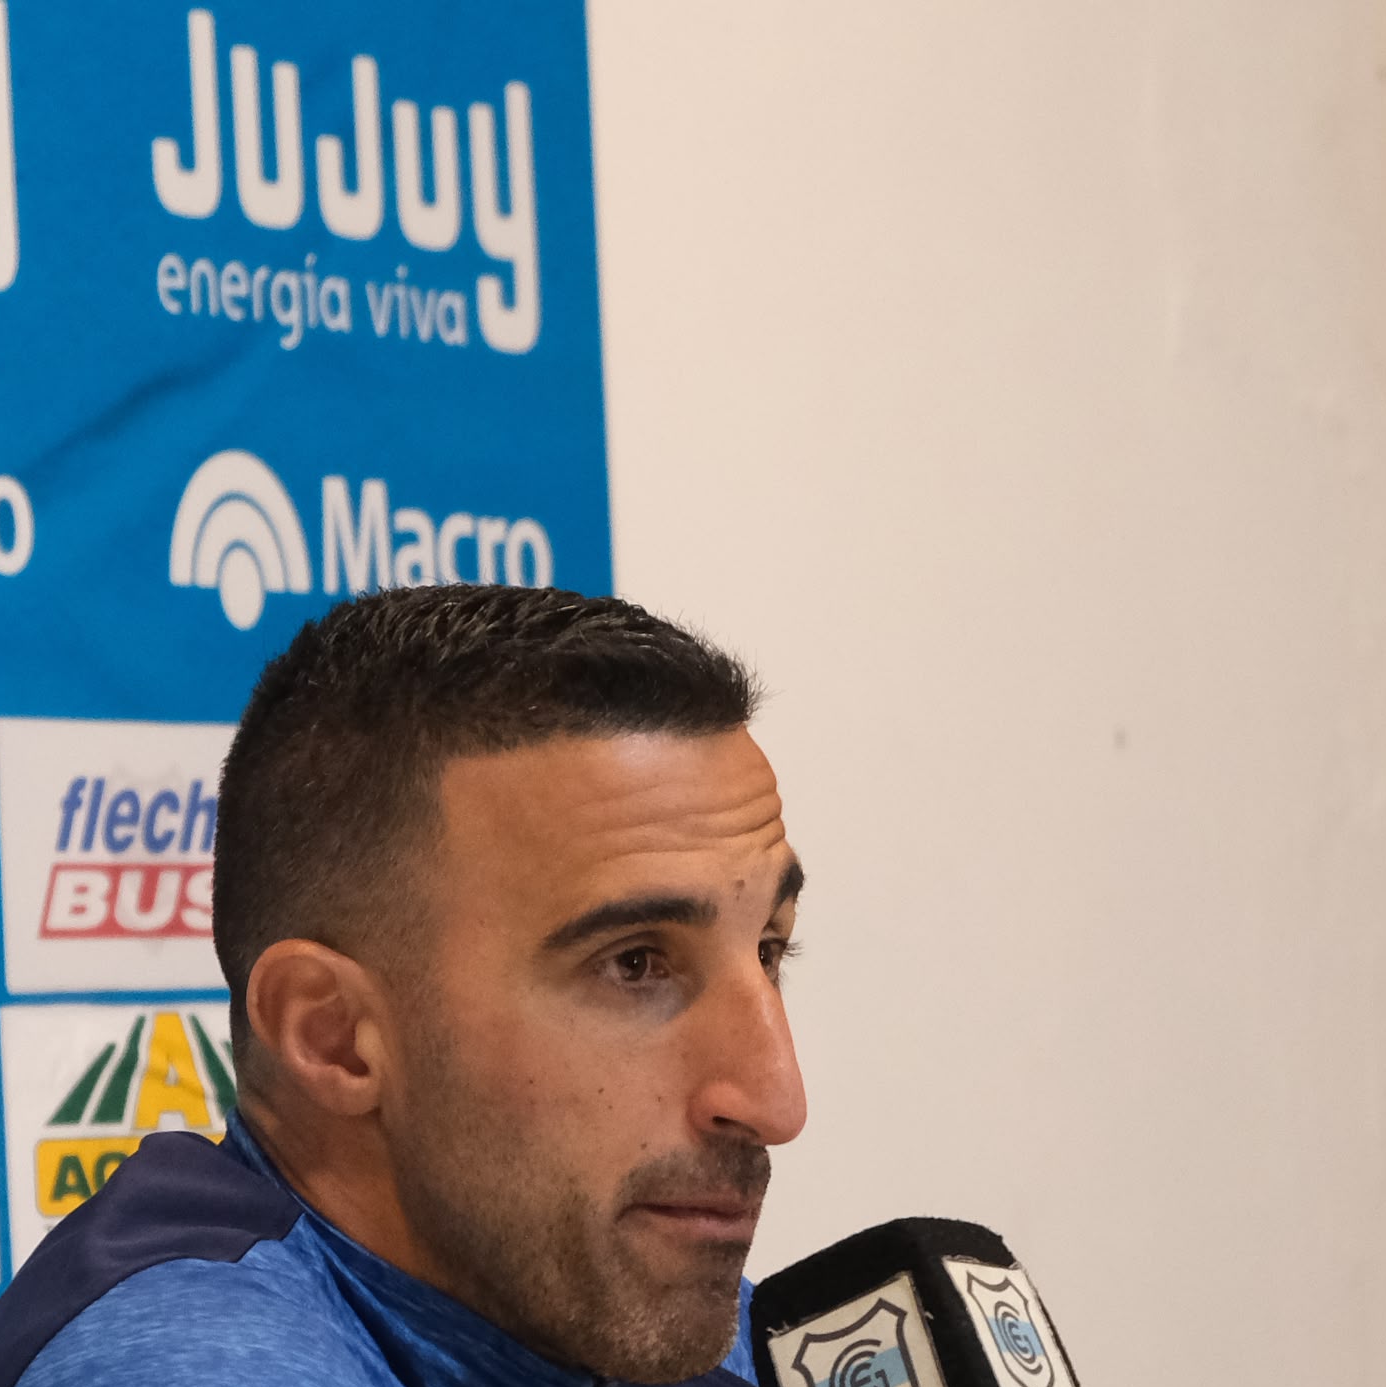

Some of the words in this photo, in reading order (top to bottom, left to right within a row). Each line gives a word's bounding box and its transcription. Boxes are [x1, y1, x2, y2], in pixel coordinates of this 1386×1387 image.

[156, 252, 352, 350] energía
[365, 264, 469, 347] viva
[321, 474, 554, 596] Macro
[55, 775, 218, 854] flech
